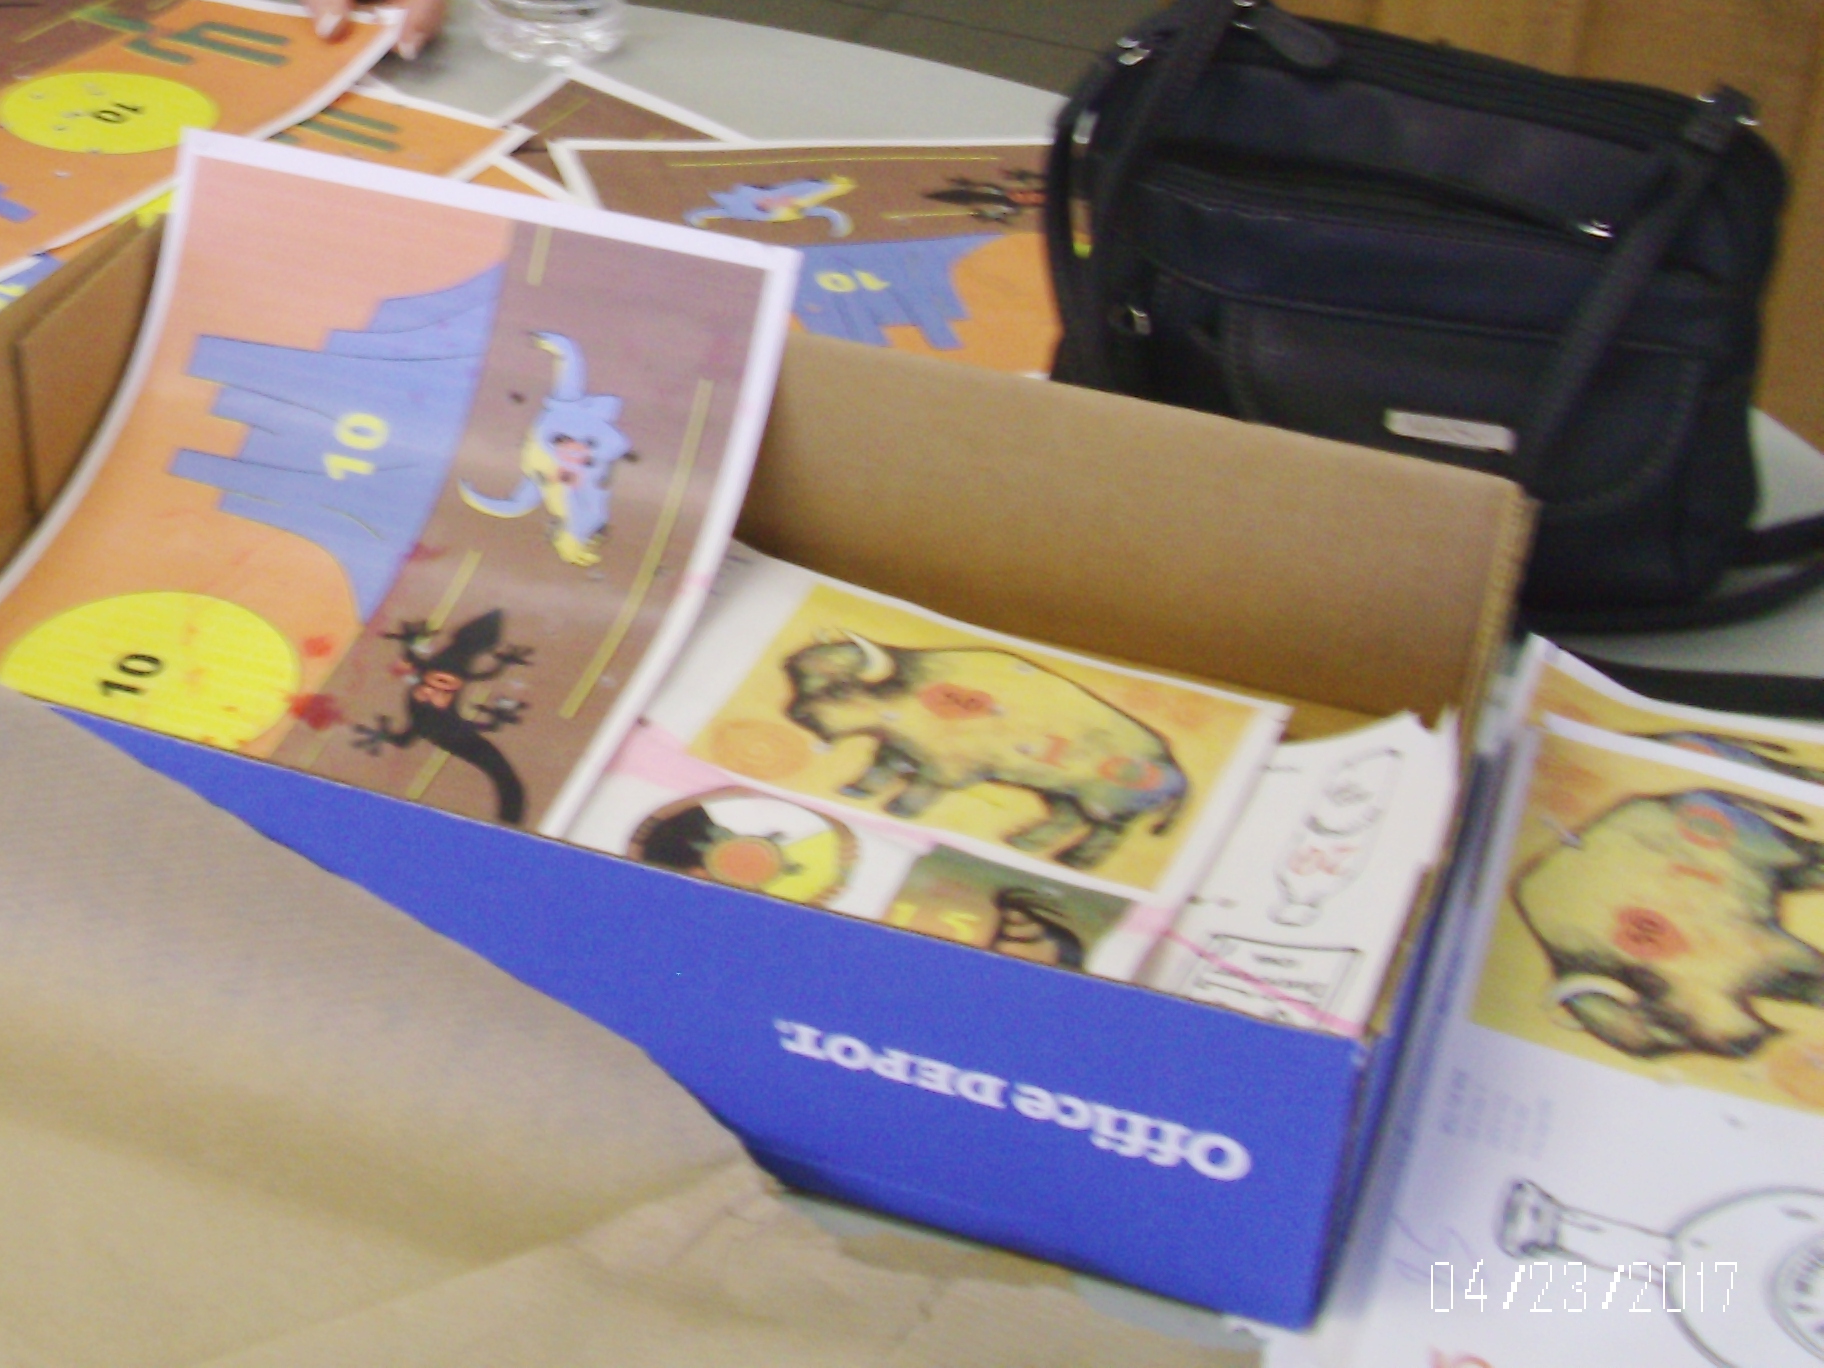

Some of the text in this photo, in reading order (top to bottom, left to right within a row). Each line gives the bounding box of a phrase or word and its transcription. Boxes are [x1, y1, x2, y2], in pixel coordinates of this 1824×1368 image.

[91, 101, 145, 125] 10
[814, 269, 891, 292] 10
[324, 412, 388, 480] 10
[99, 652, 164, 697] 10
[1012, 1083, 1252, 1181] Office
